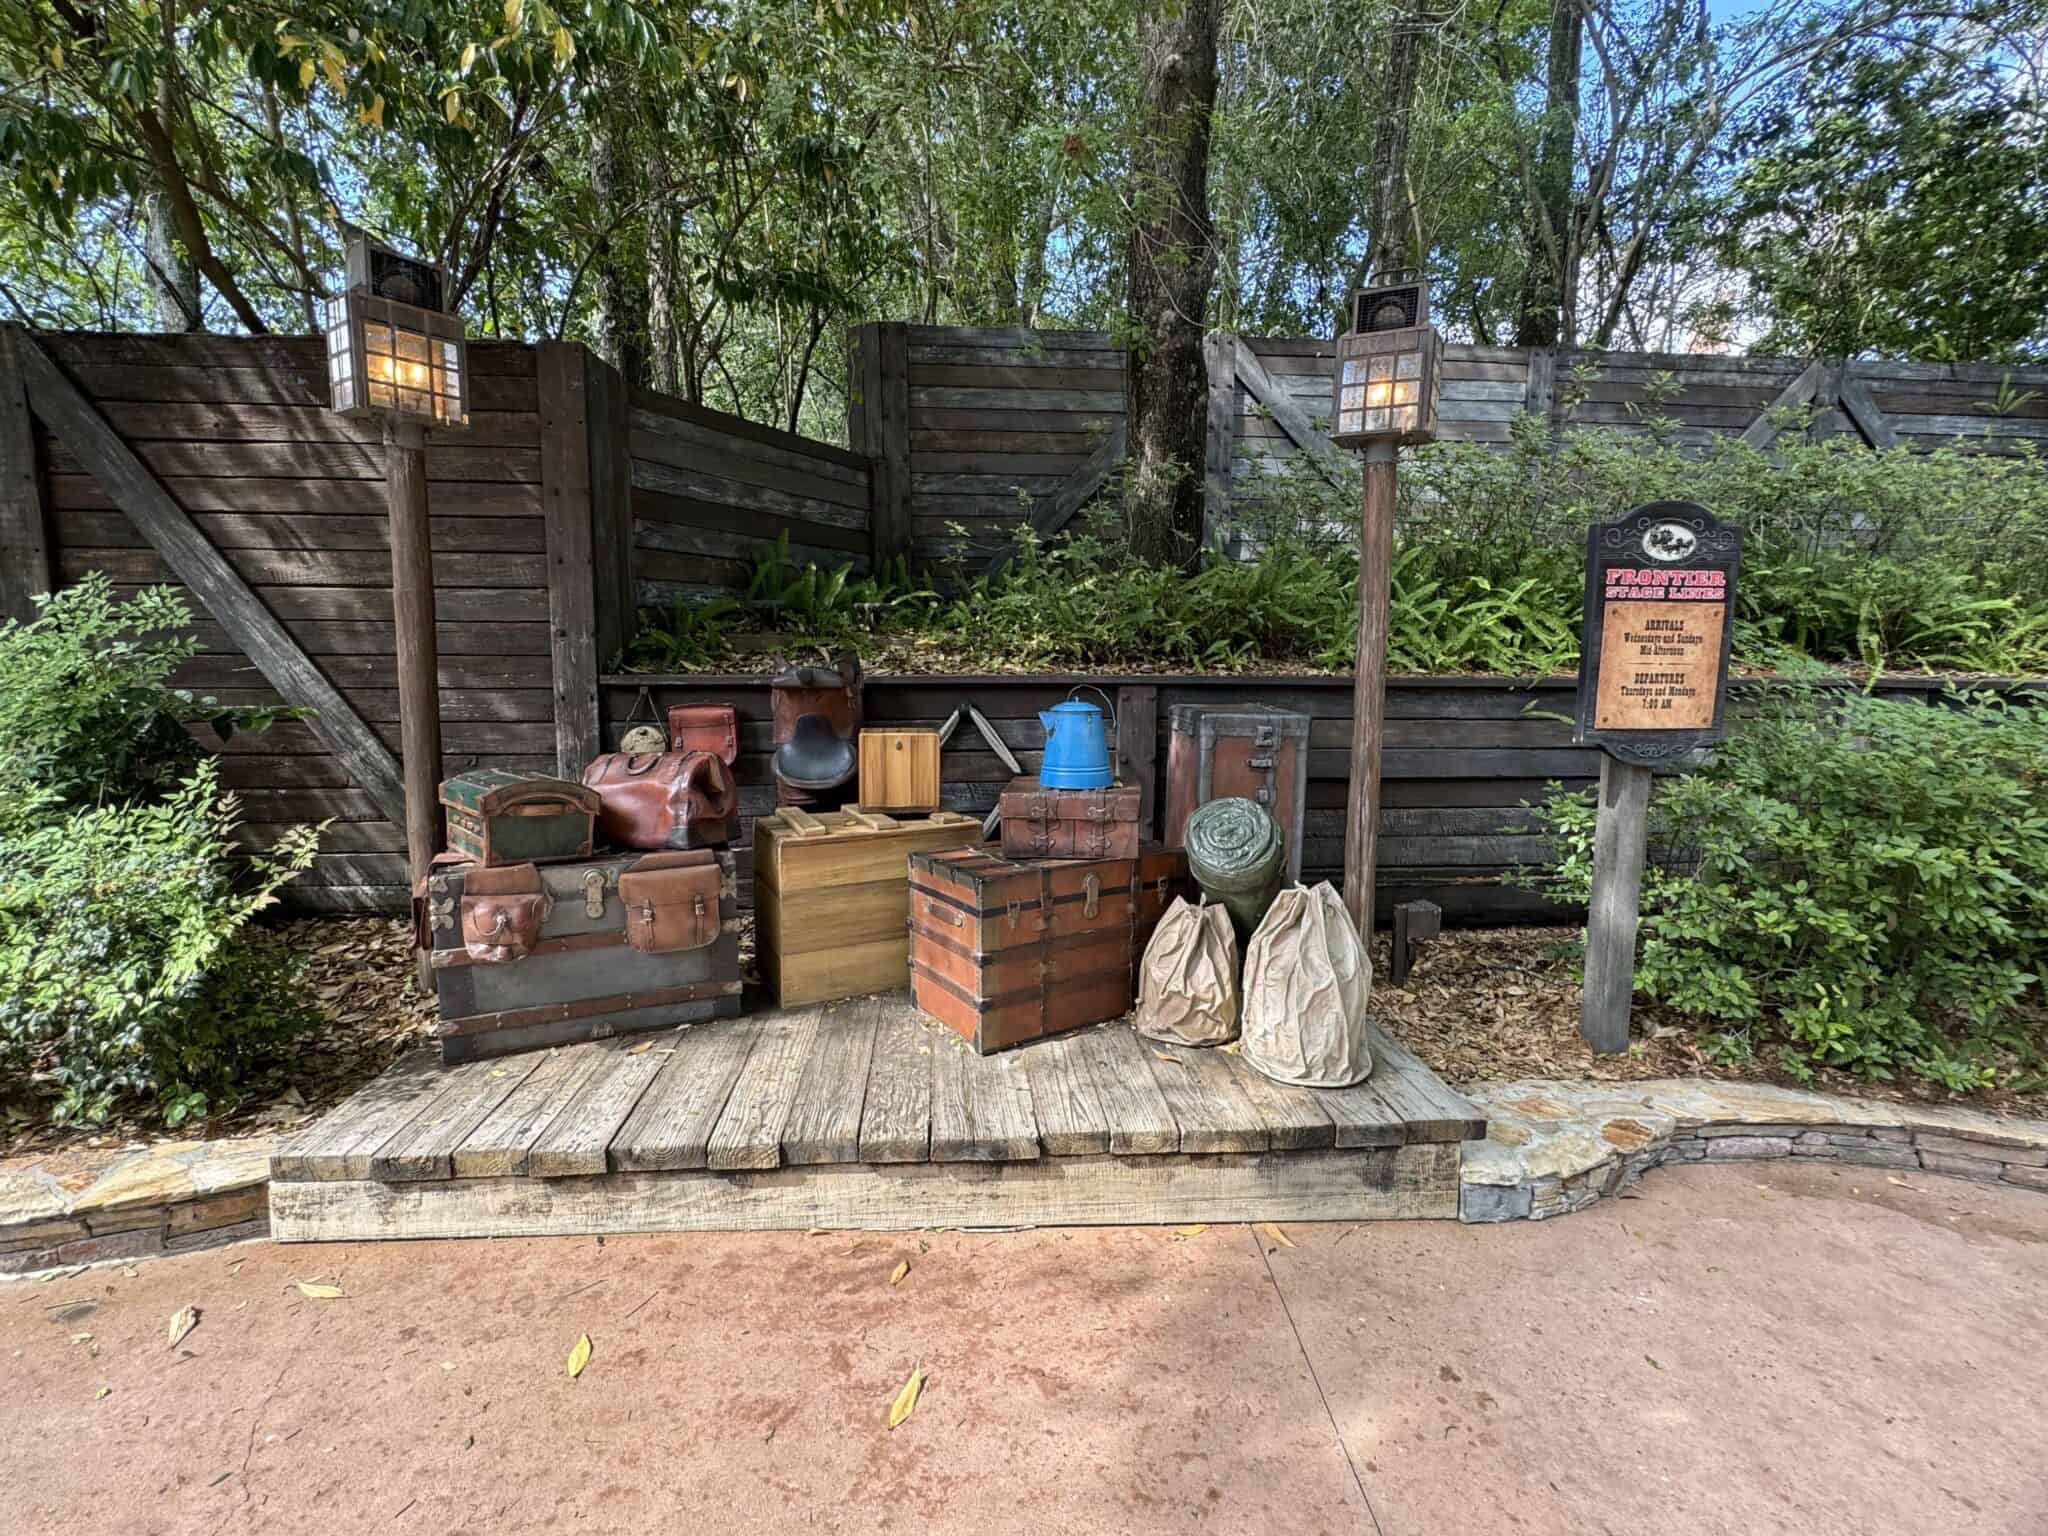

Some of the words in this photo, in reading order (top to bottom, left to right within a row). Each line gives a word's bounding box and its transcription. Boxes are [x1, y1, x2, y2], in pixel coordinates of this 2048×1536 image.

[1606, 569, 1726, 586] FRONTIER
[1605, 586, 1665, 599] STAGE
[1668, 588, 1725, 599] LINES
[1645, 620, 1684, 631] ARRIVALS
[1624, 633, 1662, 644] Wednesdays
[1663, 634, 1675, 643] and
[1677, 634, 1703, 645] Sundays
[1640, 645, 1651, 655] Mid
[1653, 646, 1684, 655] Afternoon
[1634, 673, 1684, 684] DEPARTURES
[1621, 686, 1653, 697] Thursdays
[1655, 687, 1666, 696] and
[1669, 687, 1696, 698] Mondays
[1661, 699, 1672, 709] AM
